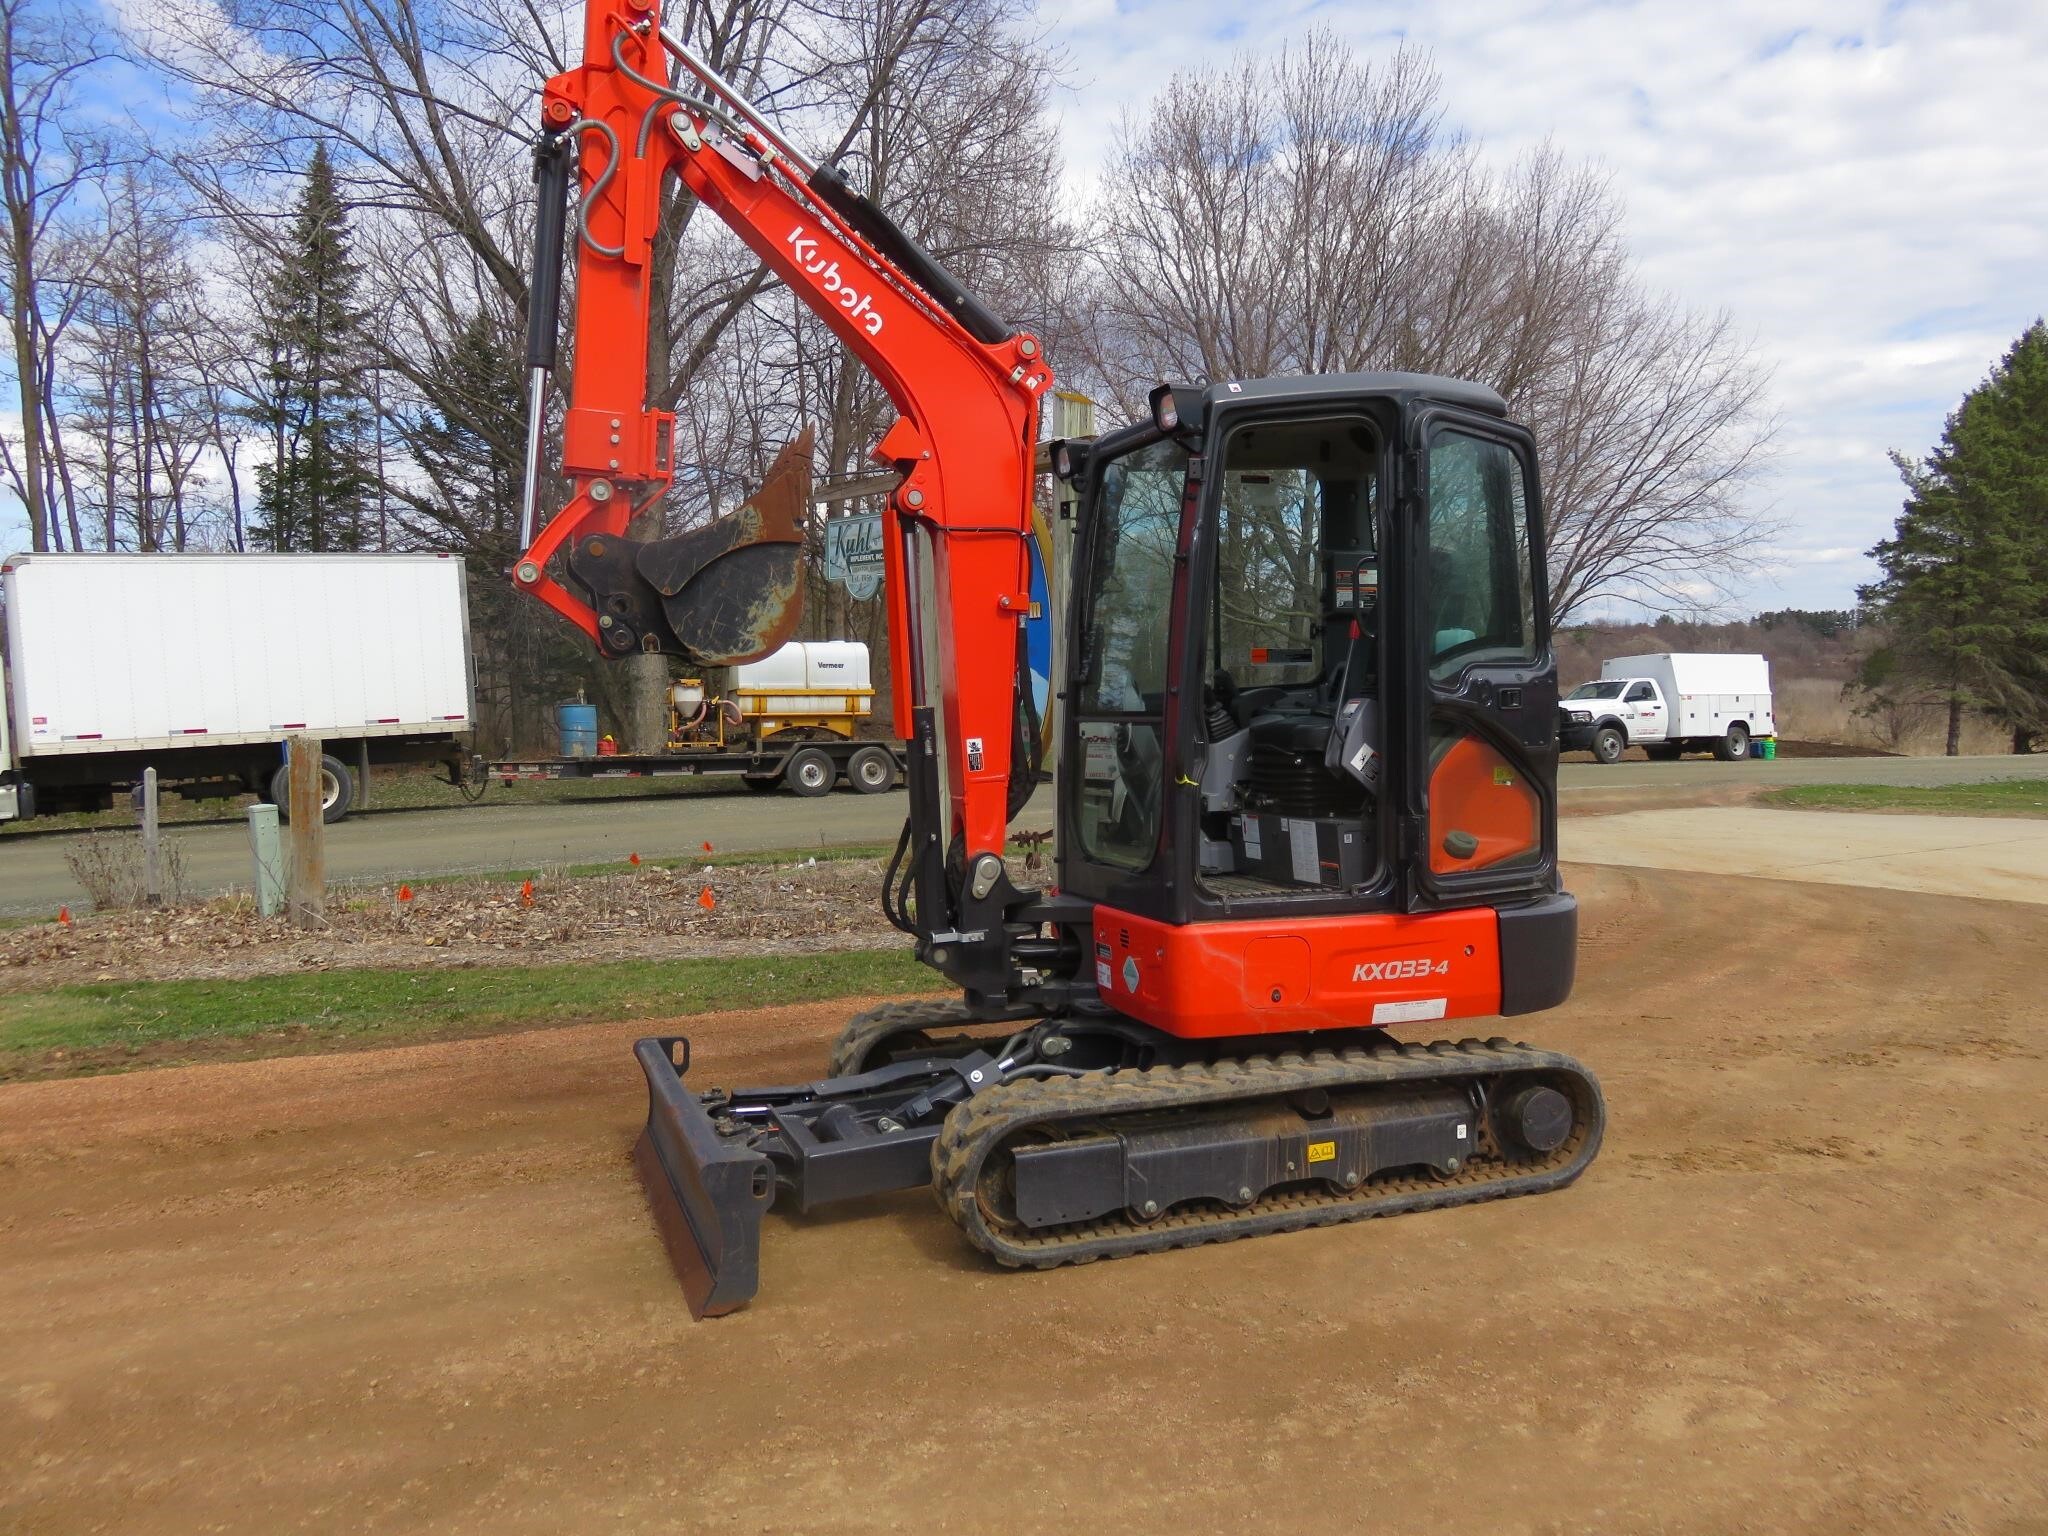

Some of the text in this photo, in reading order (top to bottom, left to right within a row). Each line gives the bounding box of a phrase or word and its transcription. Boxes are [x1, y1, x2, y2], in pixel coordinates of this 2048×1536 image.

[786, 225, 883, 336] Kubota
[835, 522, 873, 558] Kuhl
[817, 661, 845, 669] Vermeer
[1351, 958, 1449, 982] KX033-4
